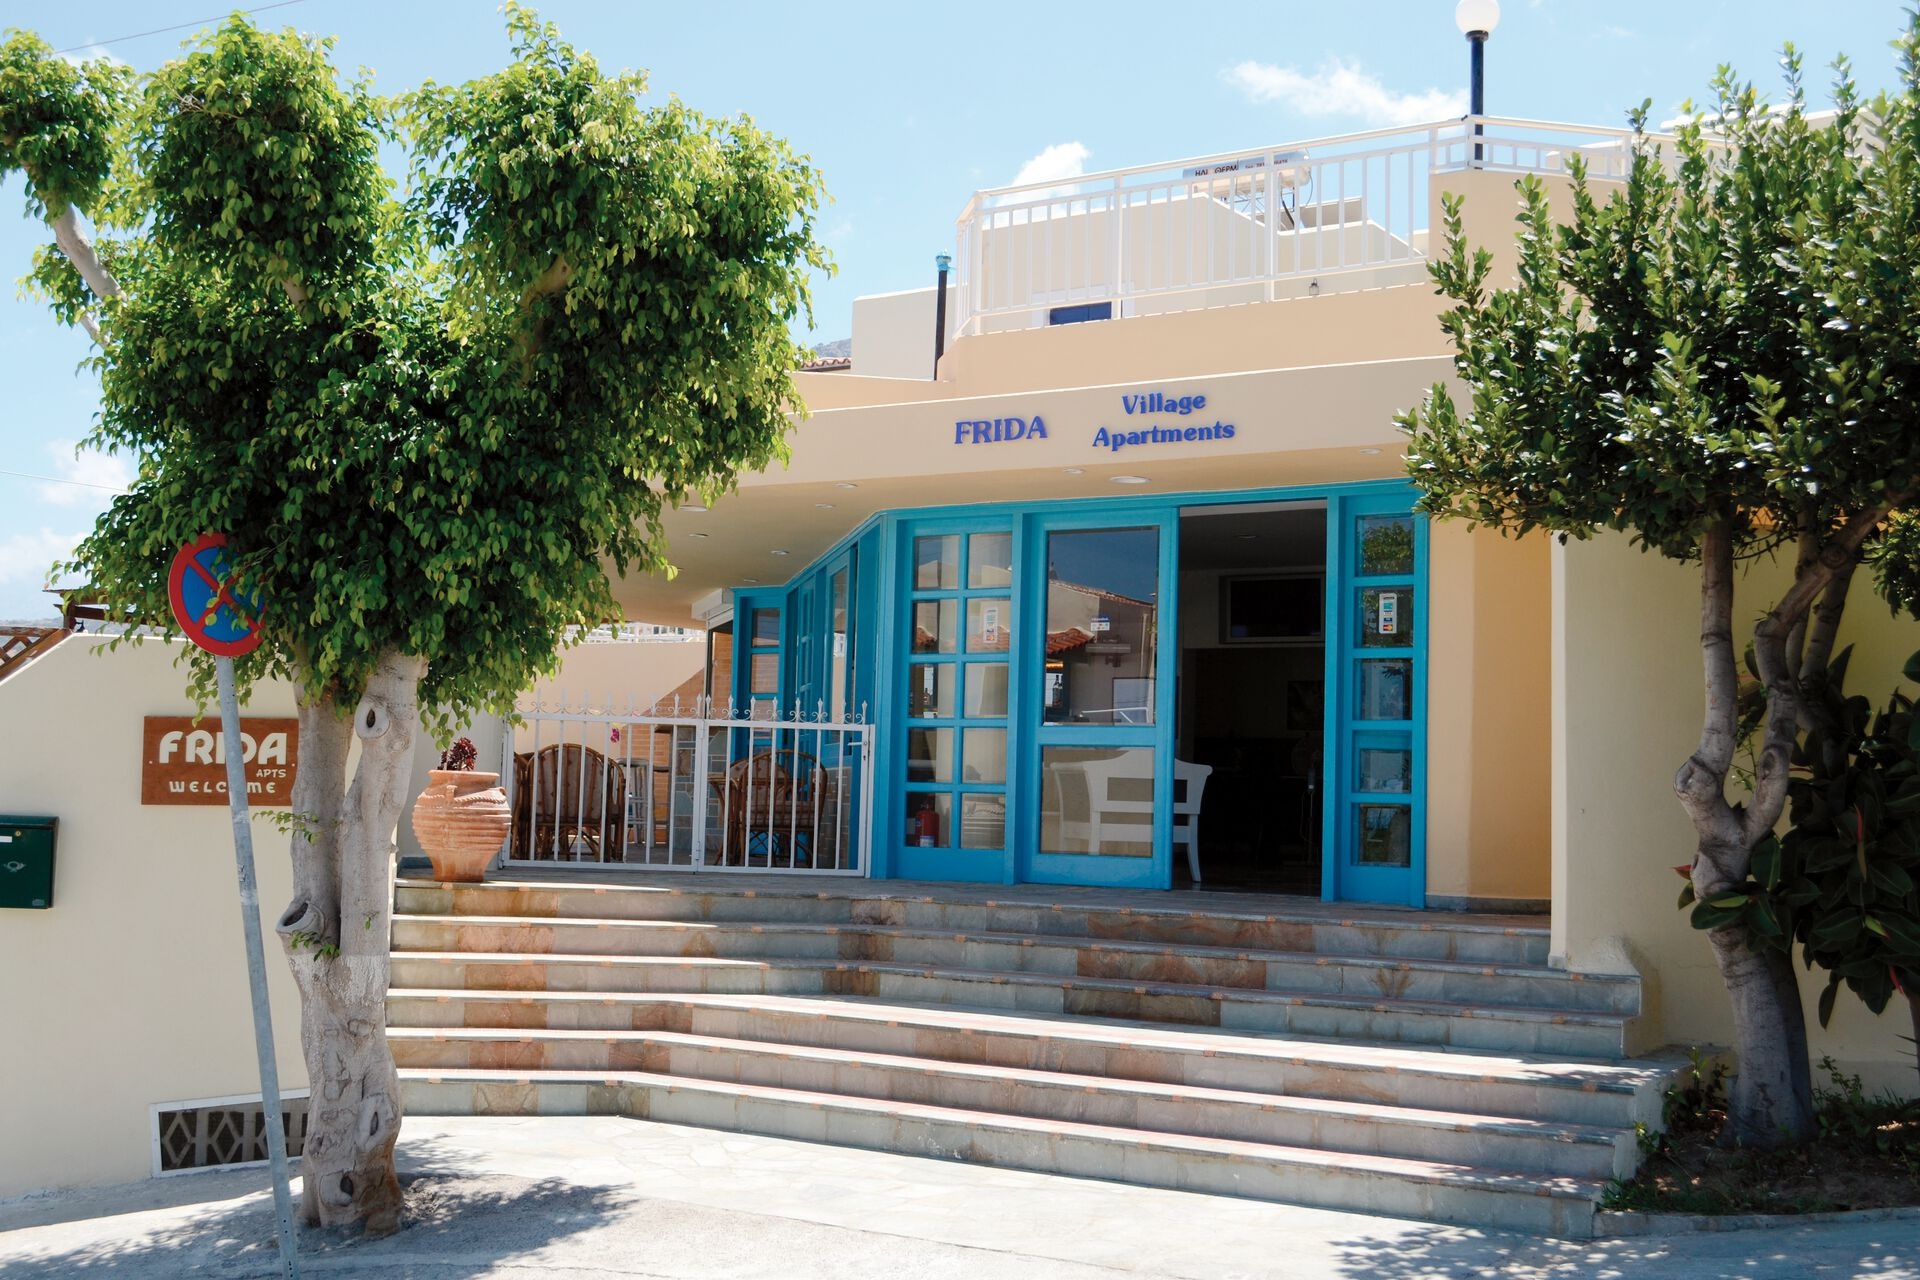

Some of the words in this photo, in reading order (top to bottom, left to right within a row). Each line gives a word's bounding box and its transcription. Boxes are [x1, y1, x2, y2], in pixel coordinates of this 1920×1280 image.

[1122, 393, 1206, 415] Village
[954, 416, 1048, 444] FRIDA
[1092, 421, 1236, 451] Apartments
[158, 730, 288, 765] FRIDA
[256, 769, 287, 778] APTS
[169, 781, 276, 793] WELCME
